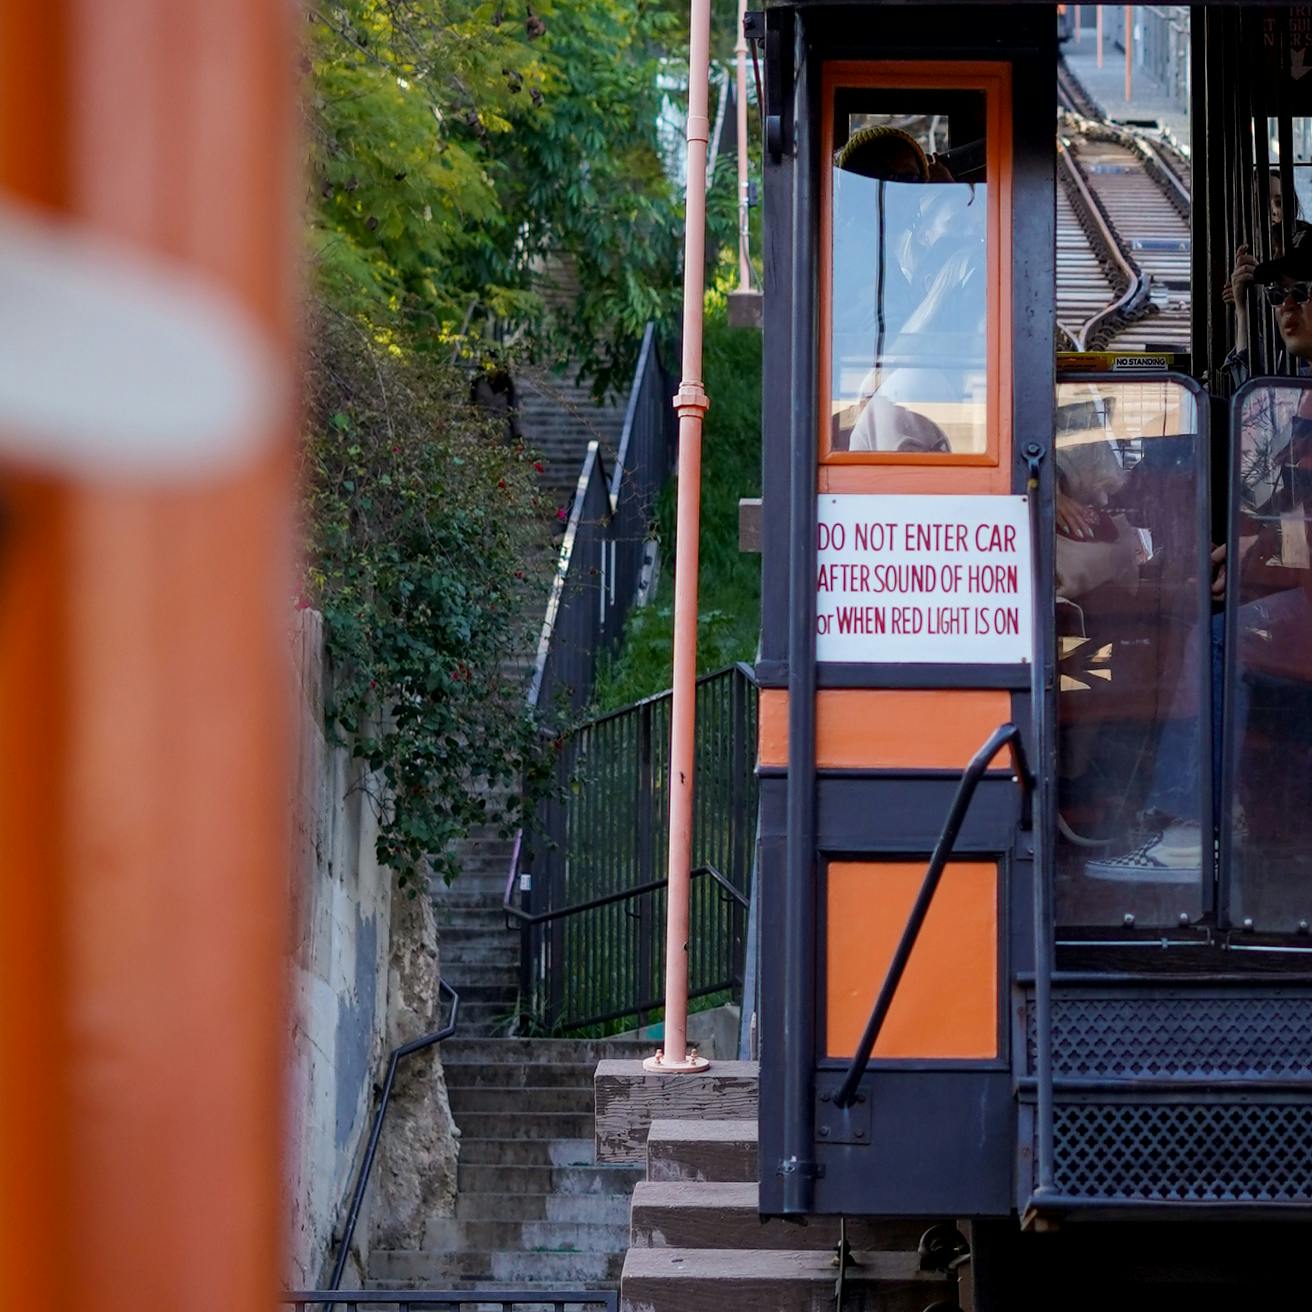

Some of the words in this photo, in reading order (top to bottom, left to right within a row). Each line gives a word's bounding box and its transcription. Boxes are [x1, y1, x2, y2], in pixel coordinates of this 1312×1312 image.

[1116, 358, 1128, 366] NO
[1129, 358, 1166, 366] STANDING
[817, 522, 845, 551] DO
[855, 523, 898, 551] NOT
[905, 524, 969, 552] ENTER
[975, 524, 1017, 552] CAR
[817, 564, 871, 593] AFTER
[873, 565, 937, 593] SOUND
[941, 565, 963, 593] OF
[968, 565, 1018, 593] HORN
[817, 614, 834, 636] or
[836, 606, 886, 635] WHEN
[891, 607, 923, 635] RED
[927, 607, 970, 635] LIGHT
[975, 607, 990, 635] IS
[994, 607, 1019, 635] ON
